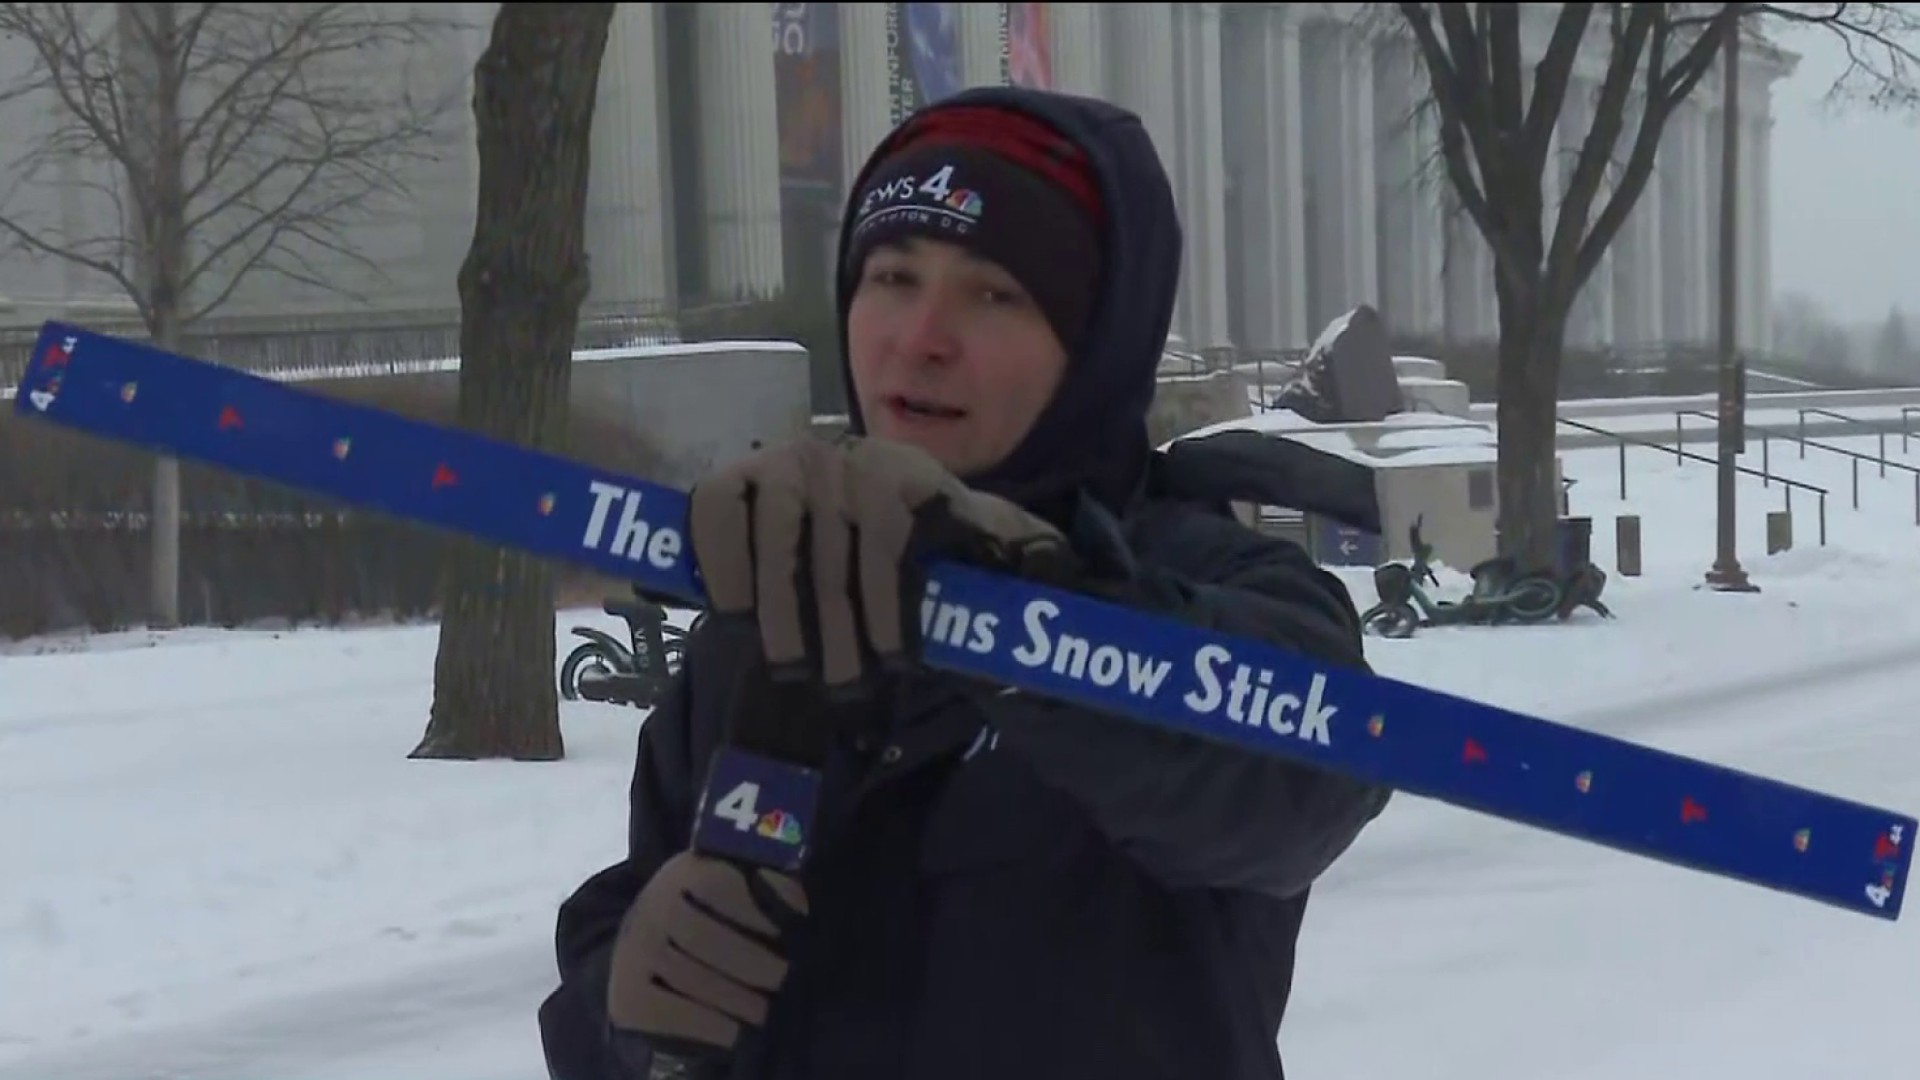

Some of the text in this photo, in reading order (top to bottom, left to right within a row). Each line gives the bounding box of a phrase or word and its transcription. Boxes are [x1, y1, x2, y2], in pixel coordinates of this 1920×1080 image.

[919, 164, 955, 201] 4
[582, 480, 682, 569] The
[1012, 599, 1172, 698] Snow
[1183, 643, 1340, 746] Stick
[714, 780, 760, 833] 4
